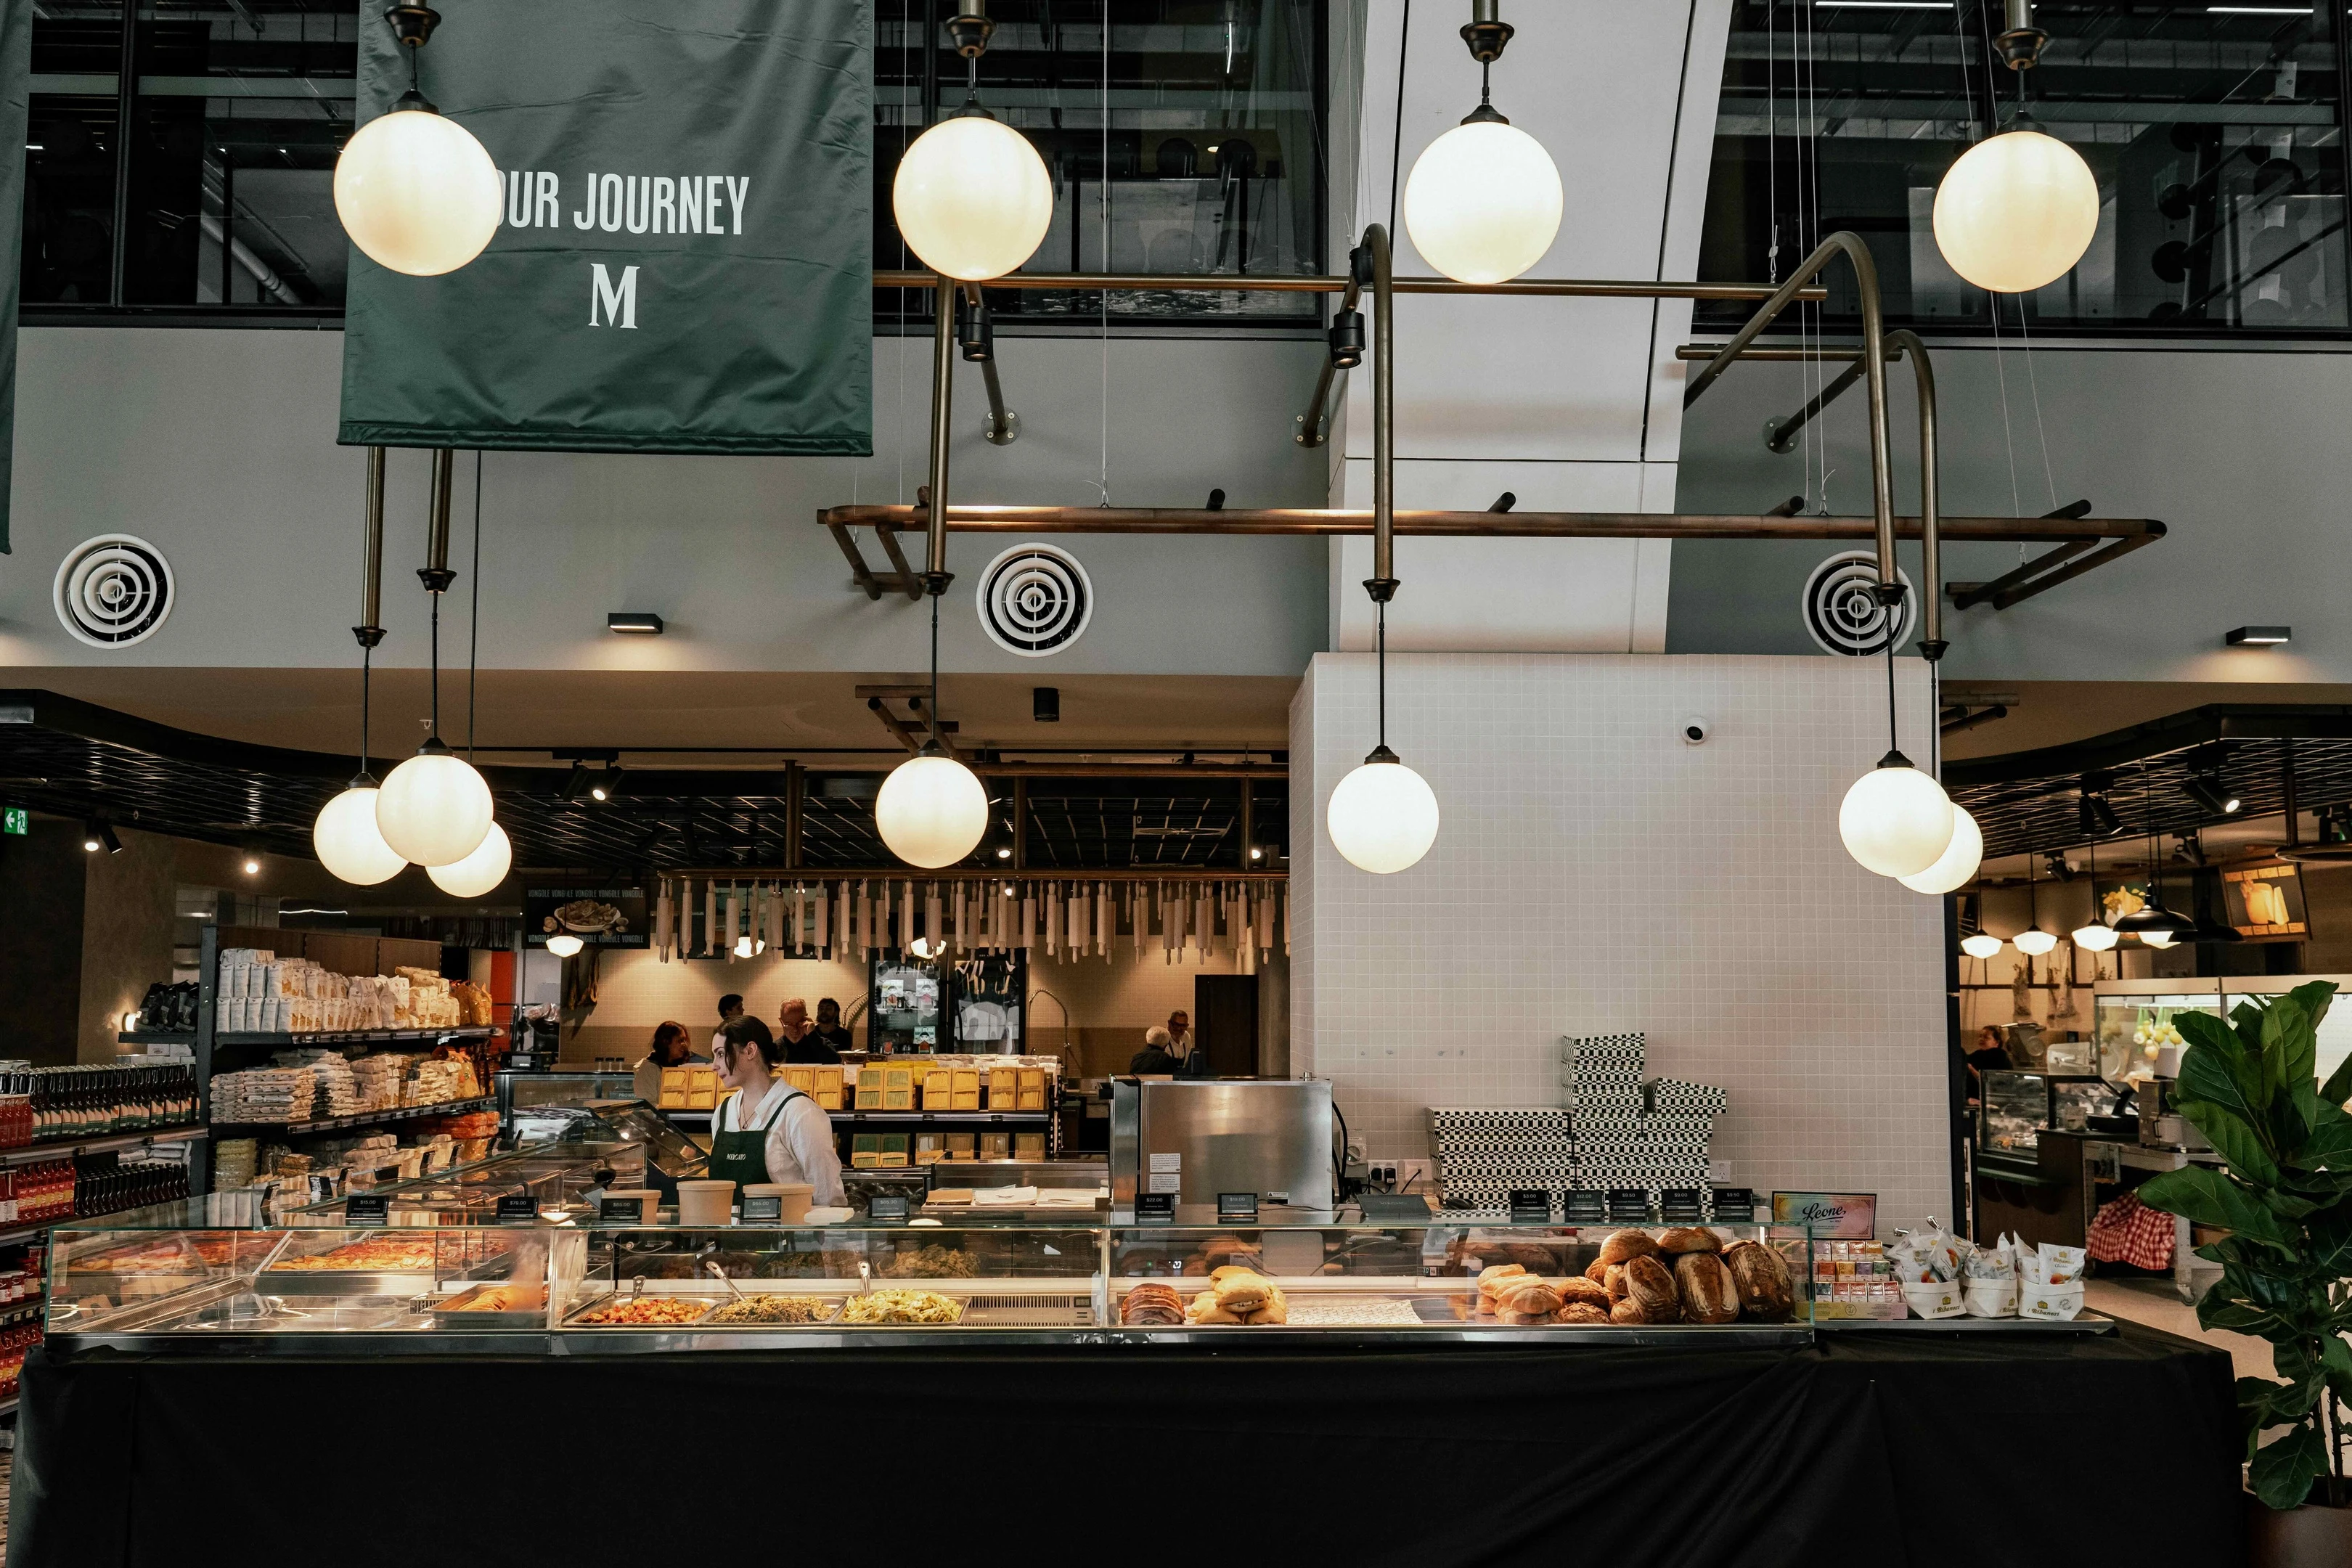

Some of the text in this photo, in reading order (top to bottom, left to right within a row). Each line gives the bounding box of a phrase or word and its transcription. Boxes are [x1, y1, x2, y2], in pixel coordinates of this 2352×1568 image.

[573, 173, 750, 235] JOURNEY
[588, 263, 640, 329] M
[1802, 1203, 1846, 1221] Leone
